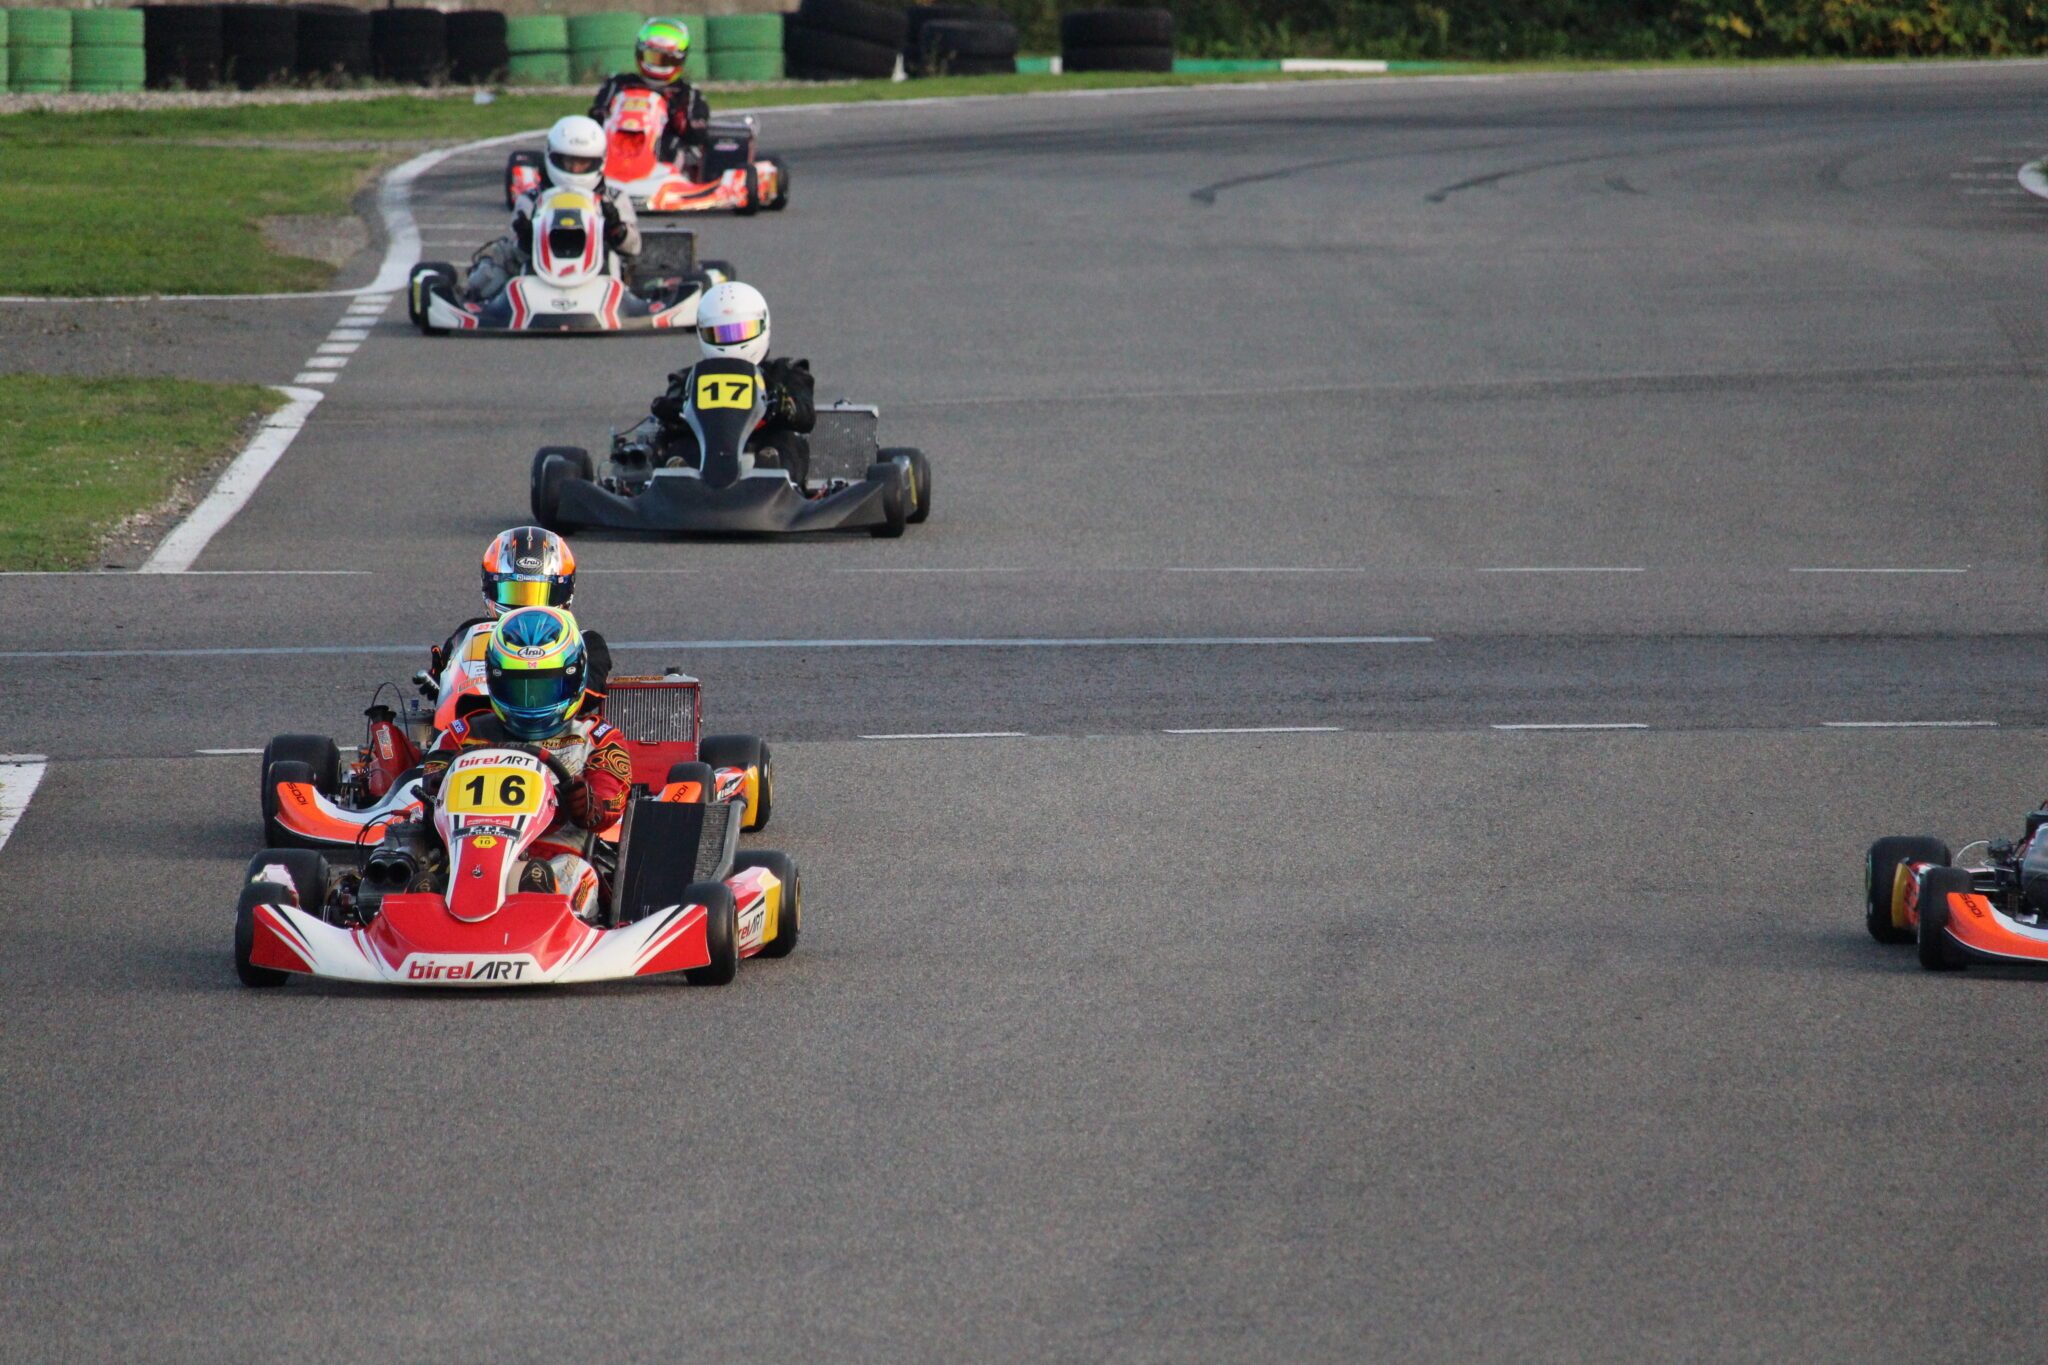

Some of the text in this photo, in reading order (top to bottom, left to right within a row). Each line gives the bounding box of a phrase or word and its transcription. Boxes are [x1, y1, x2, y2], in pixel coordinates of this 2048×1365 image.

[702, 381, 749, 401] 17
[521, 646, 541, 656] Arai
[458, 755, 534, 769] birelART
[465, 774, 526, 807] 16
[670, 784, 689, 803] ODI
[408, 961, 530, 981] birelART
